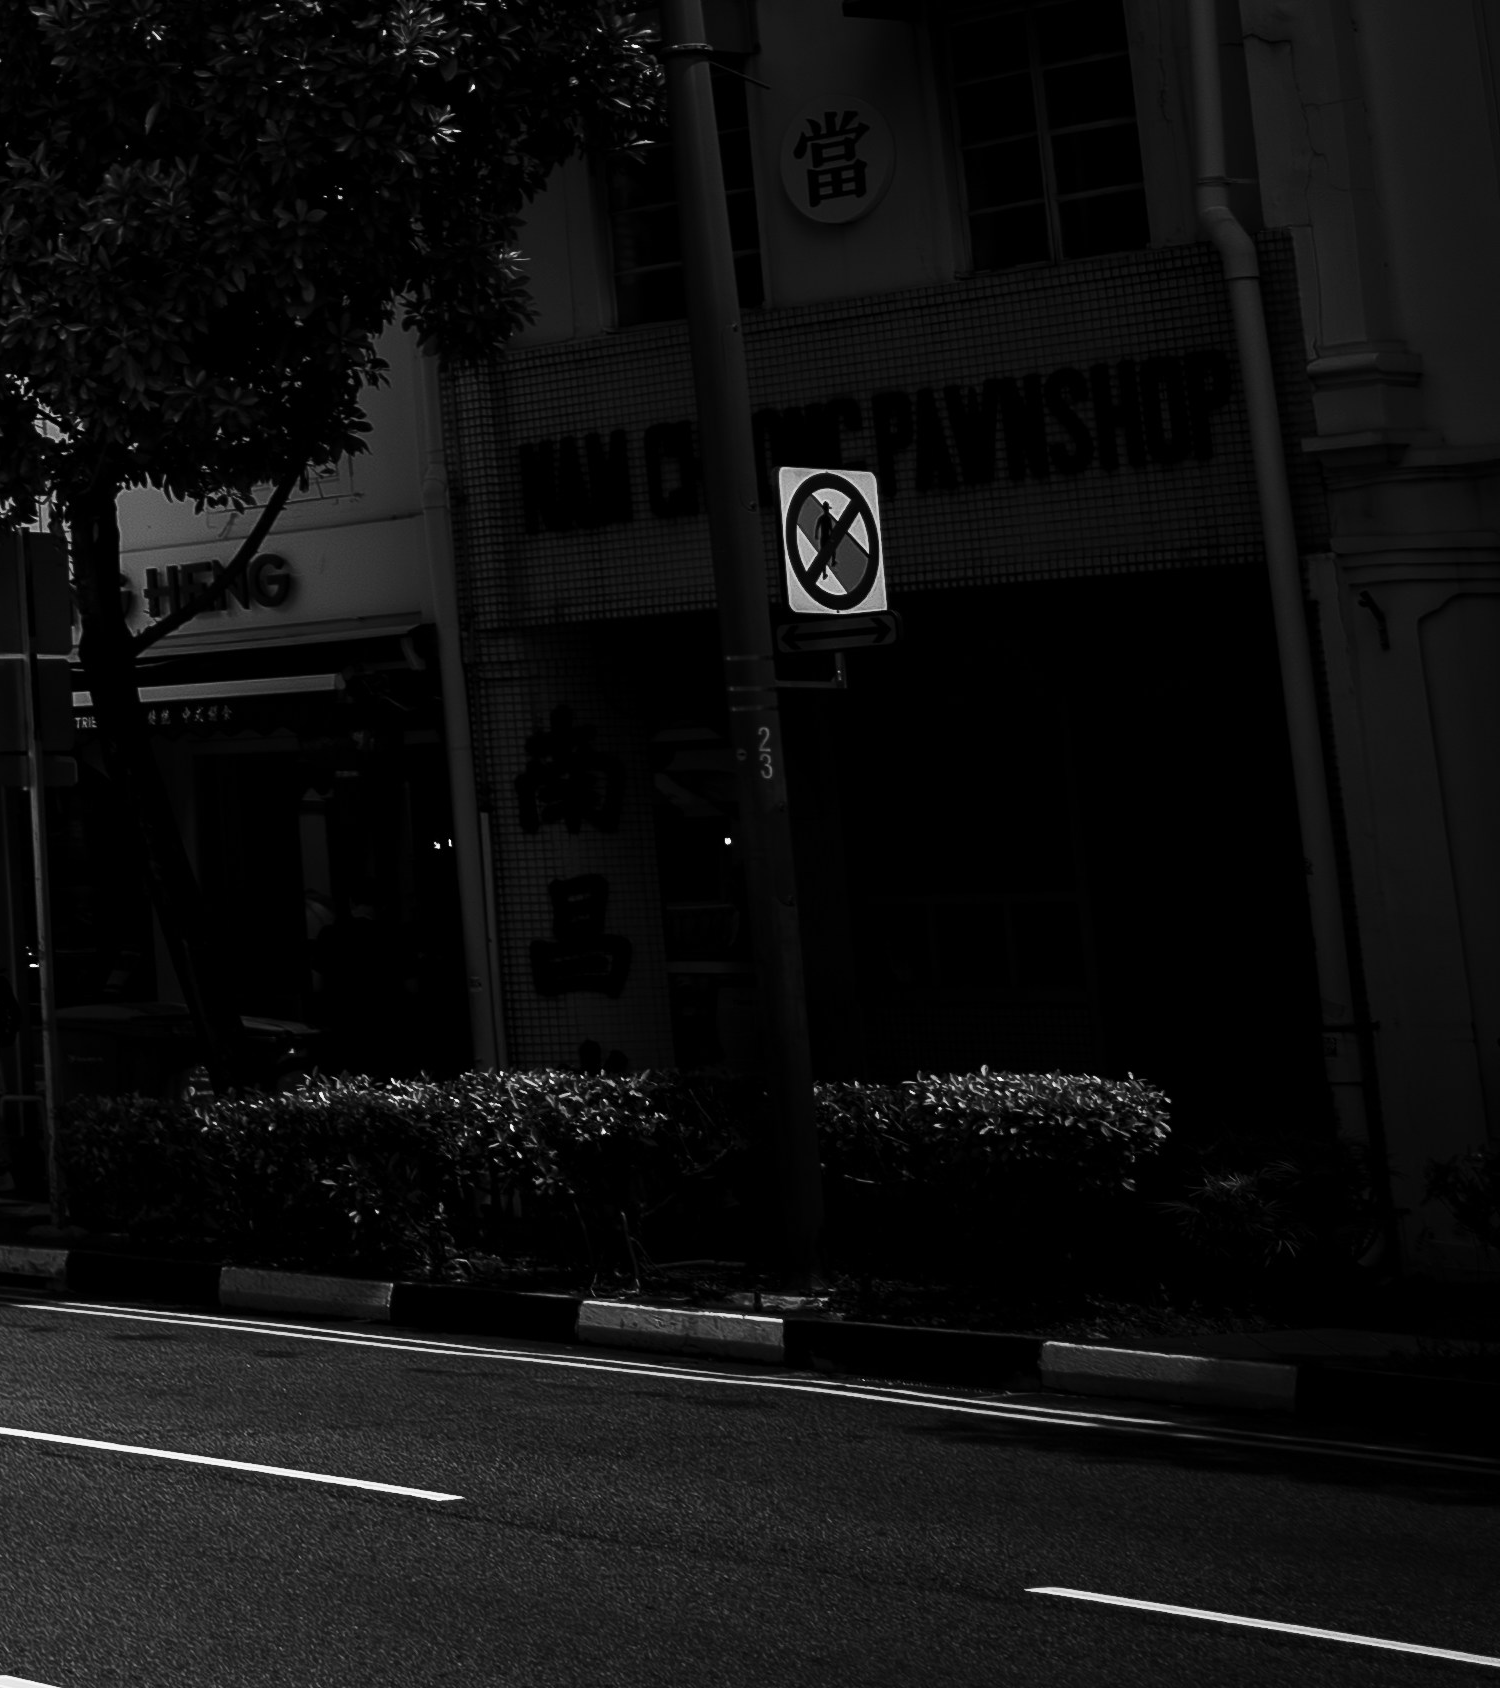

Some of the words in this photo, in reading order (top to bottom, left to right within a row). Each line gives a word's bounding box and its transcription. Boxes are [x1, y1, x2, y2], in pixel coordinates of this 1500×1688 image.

[794, 110, 869, 208] 當
[518, 427, 633, 534] NAM
[871, 350, 1232, 501] PAWNSHOP
[516, 704, 631, 1072] 南昌
